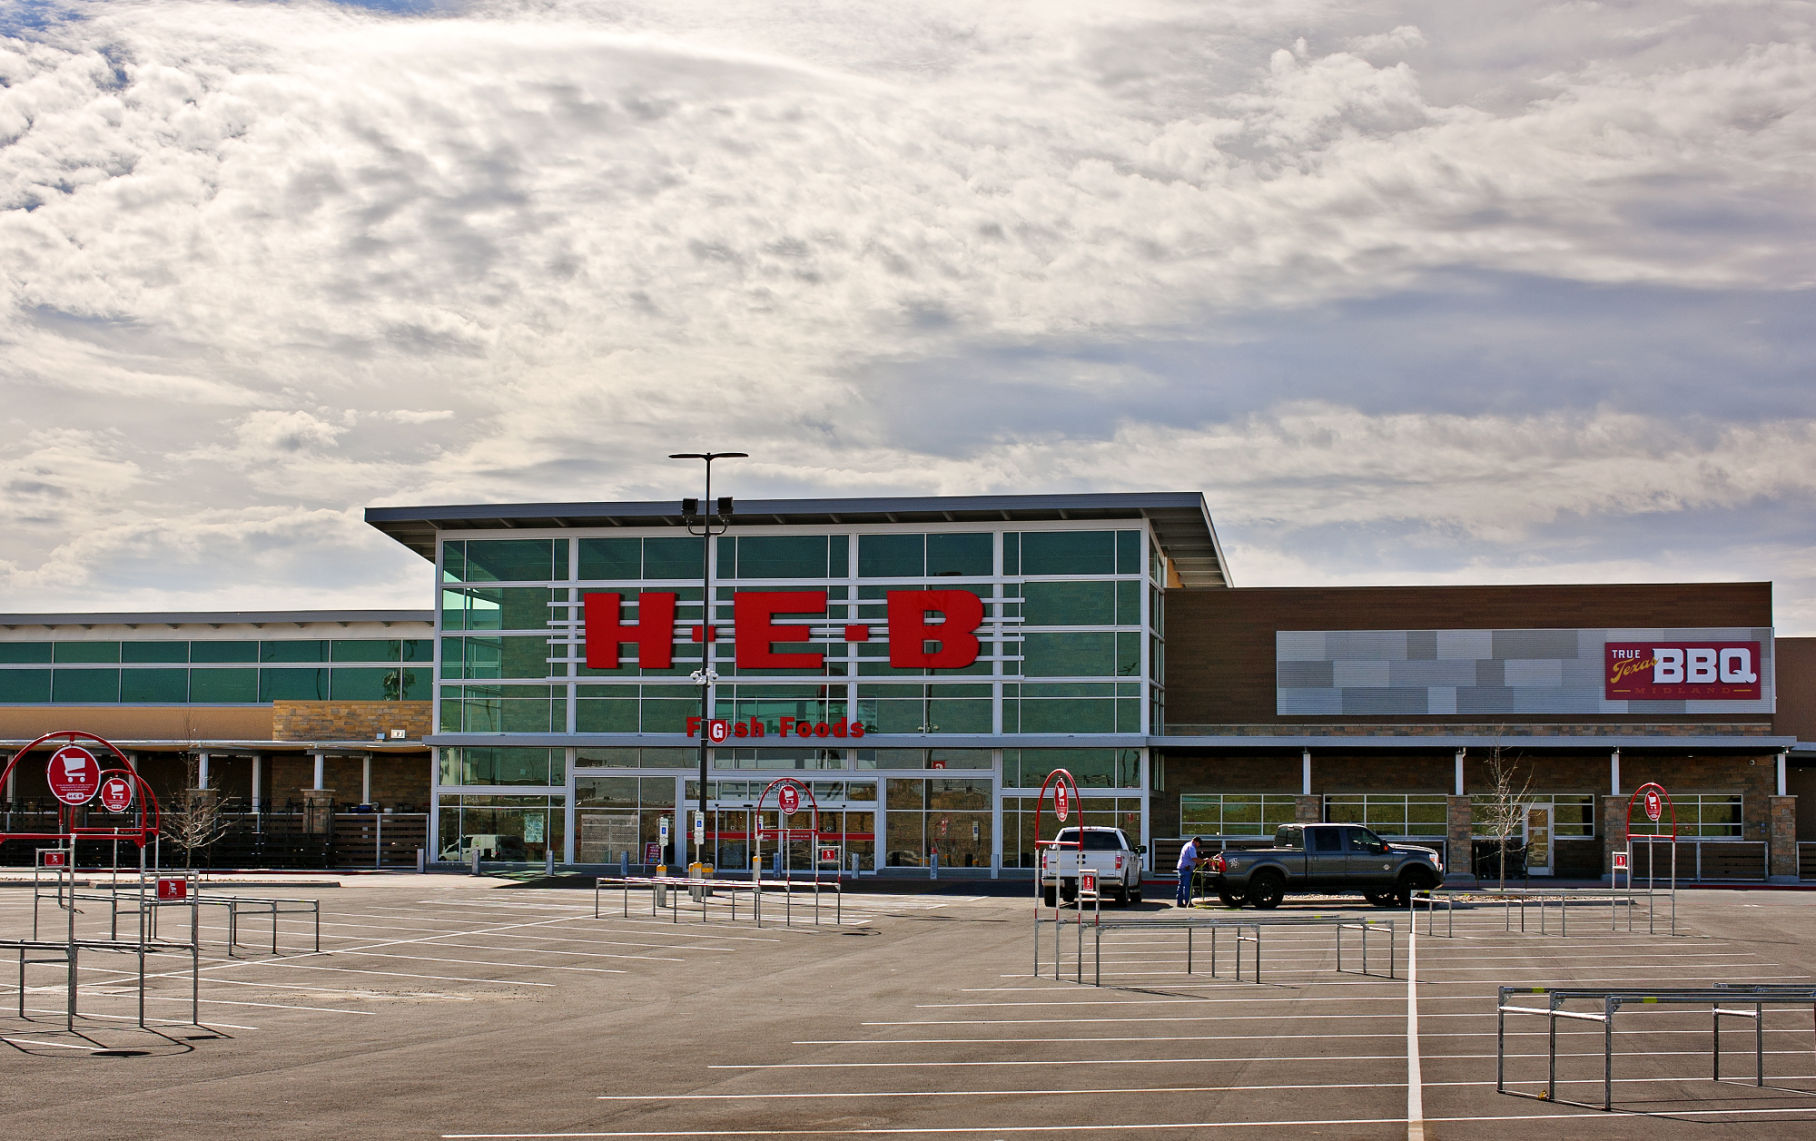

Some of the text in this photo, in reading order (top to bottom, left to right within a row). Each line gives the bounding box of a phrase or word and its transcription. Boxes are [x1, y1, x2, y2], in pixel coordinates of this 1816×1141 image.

[1611, 649, 1641, 659] TRUE
[1610, 657, 1660, 684] Texas
[1652, 647, 1757, 685] BBQ
[1634, 687, 1732, 695] MIDLAND
[686, 716, 865, 738] Fsh Foods
[712, 722, 724, 739] G
